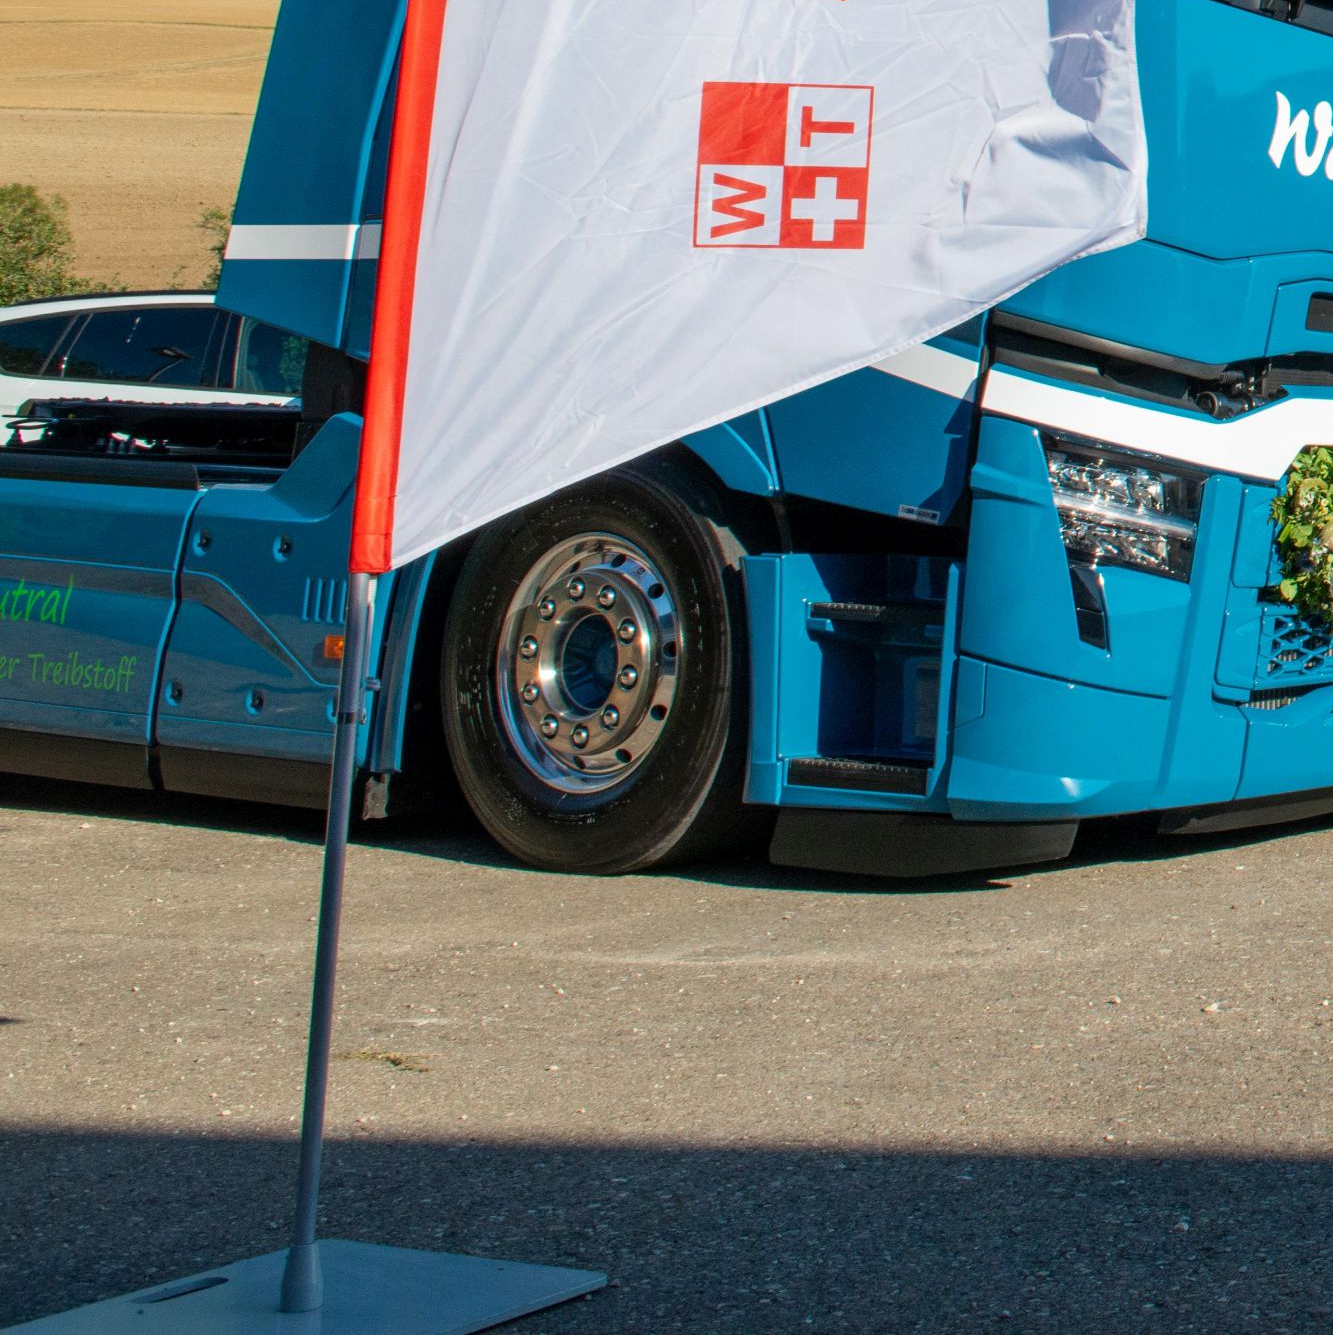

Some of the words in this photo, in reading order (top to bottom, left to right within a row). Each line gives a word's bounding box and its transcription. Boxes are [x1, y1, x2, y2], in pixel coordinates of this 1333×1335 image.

[799, 105, 855, 148] T
[710, 172, 767, 239] W
[27, 651, 136, 693] Treibstoff
